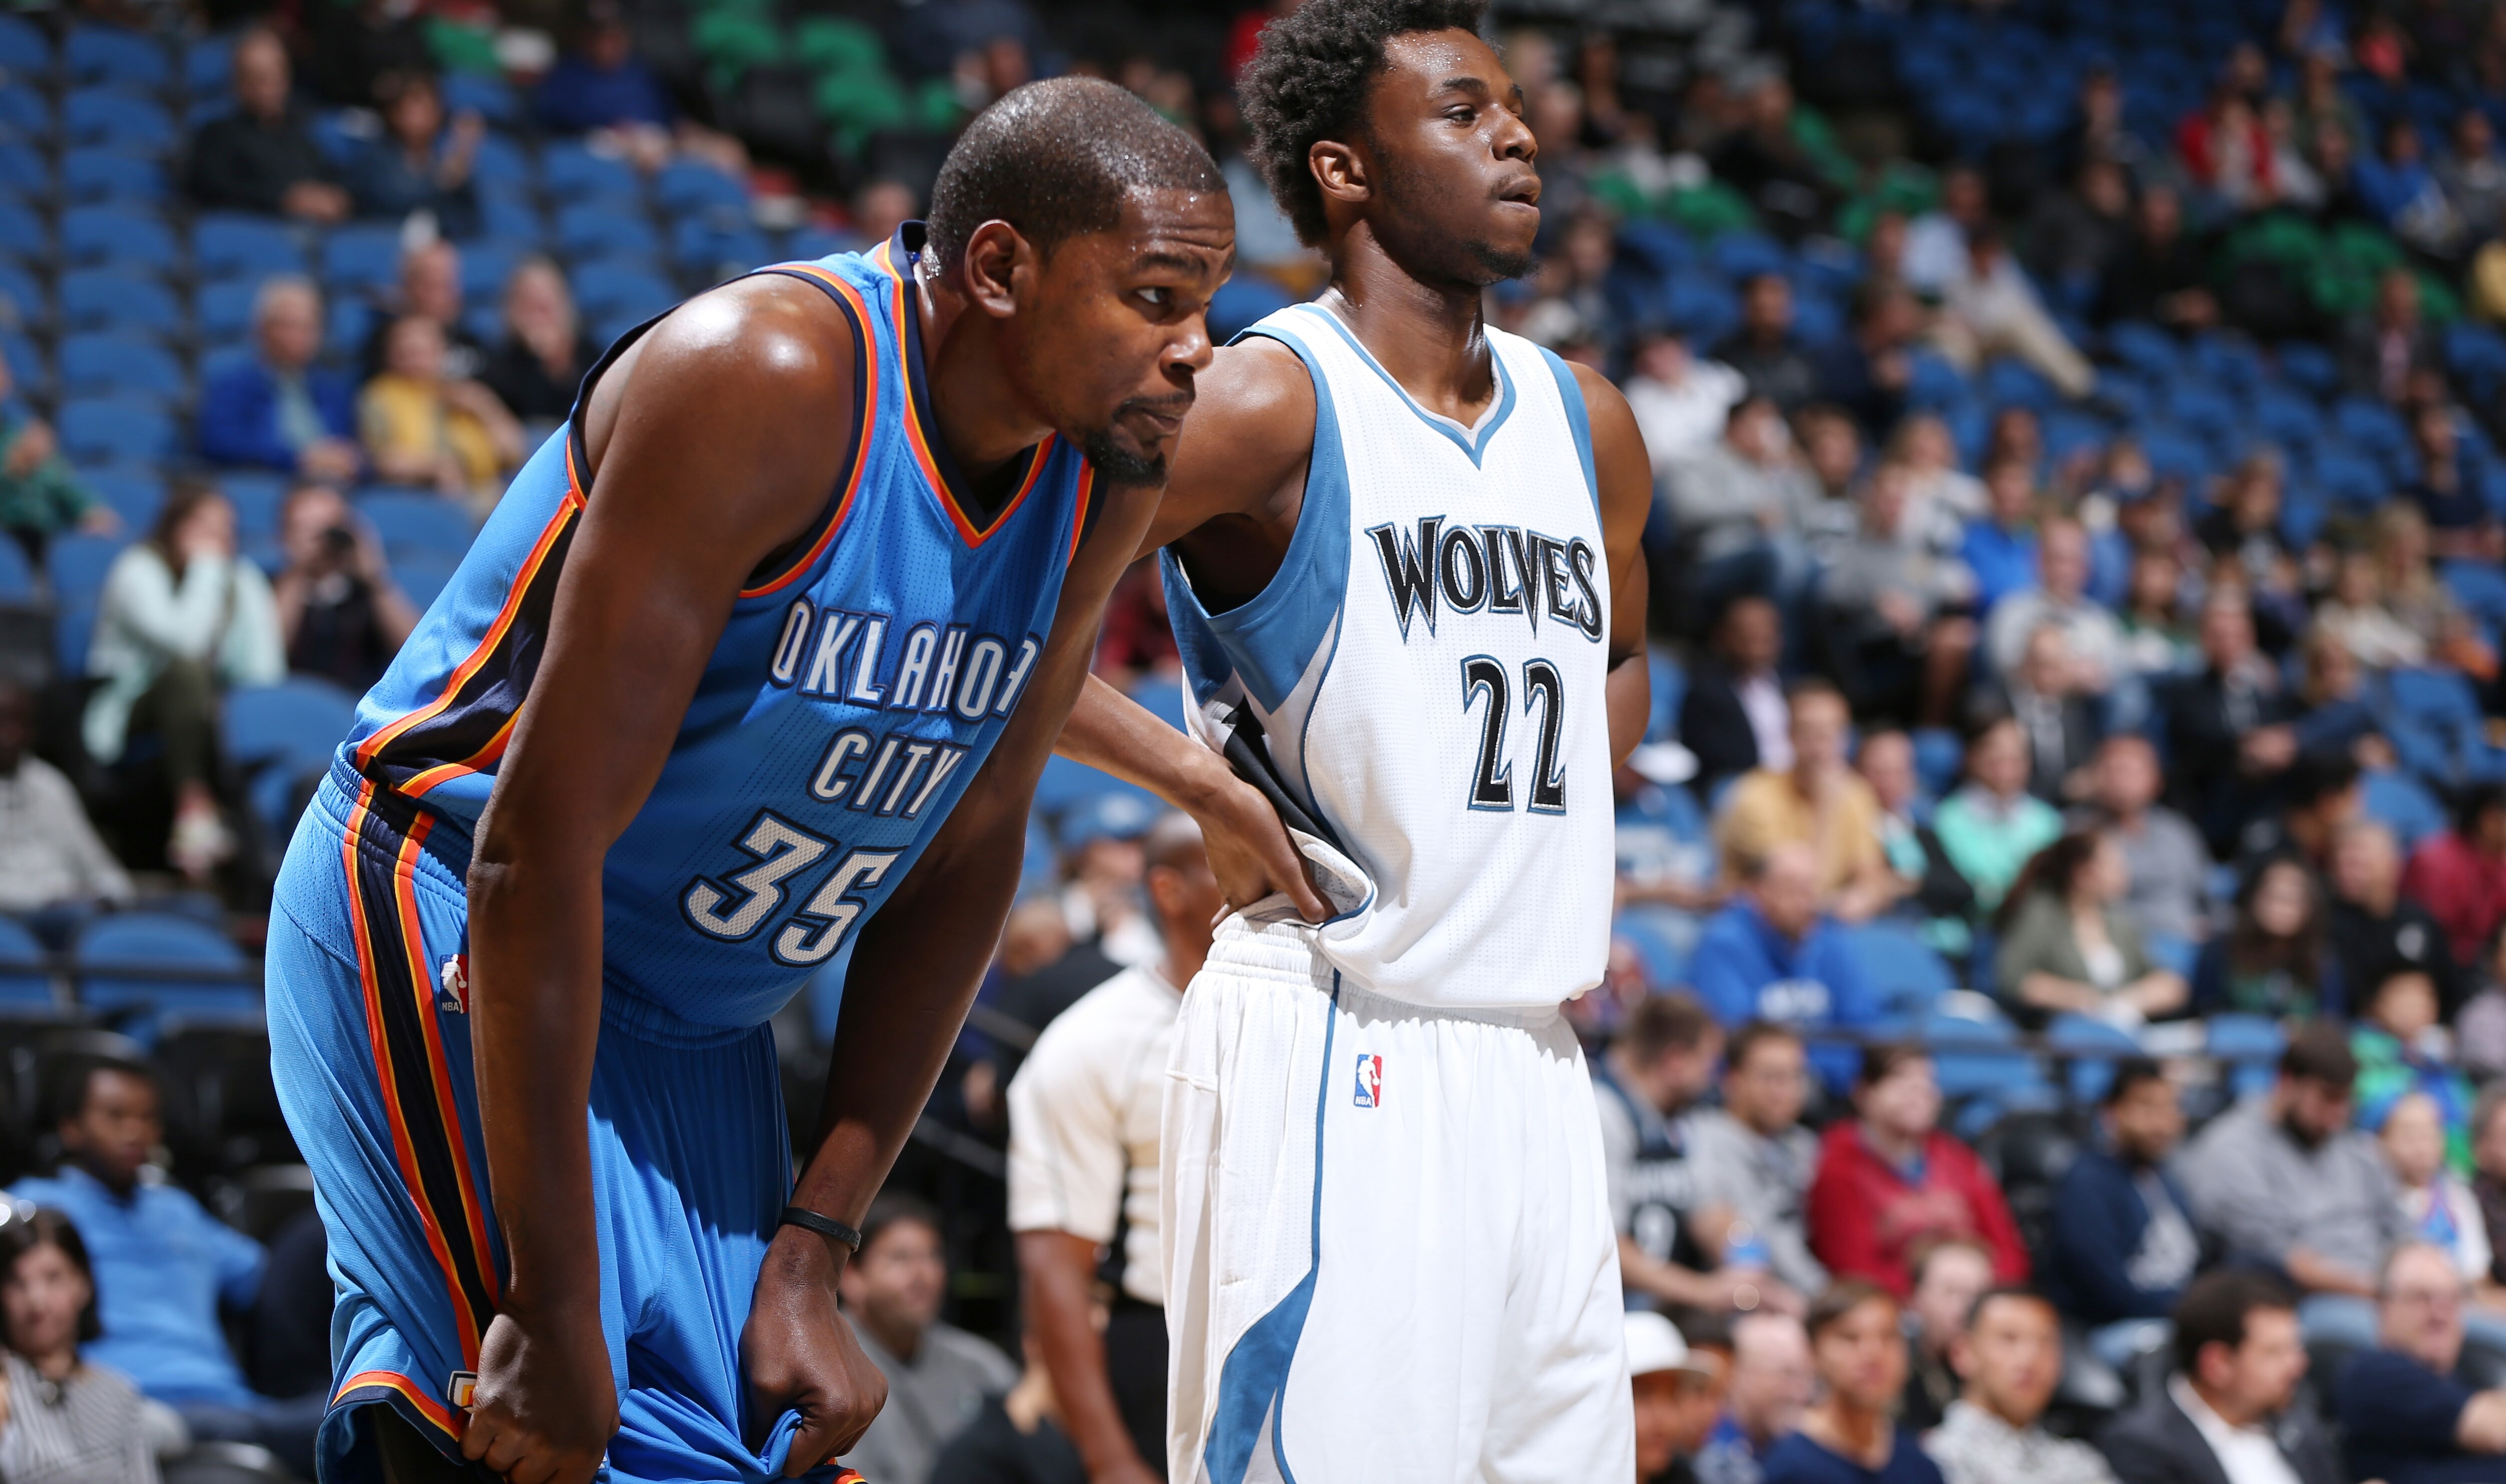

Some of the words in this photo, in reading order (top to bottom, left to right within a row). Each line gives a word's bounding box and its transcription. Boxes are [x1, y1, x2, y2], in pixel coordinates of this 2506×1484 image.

[1364, 514, 1602, 644] WOLVES
[807, 727, 970, 819] CITY
[1460, 654, 1566, 815] 22
[679, 807, 910, 967] 35
[442, 1002, 460, 1011] NBA
[1355, 1096, 1372, 1107] NBA
